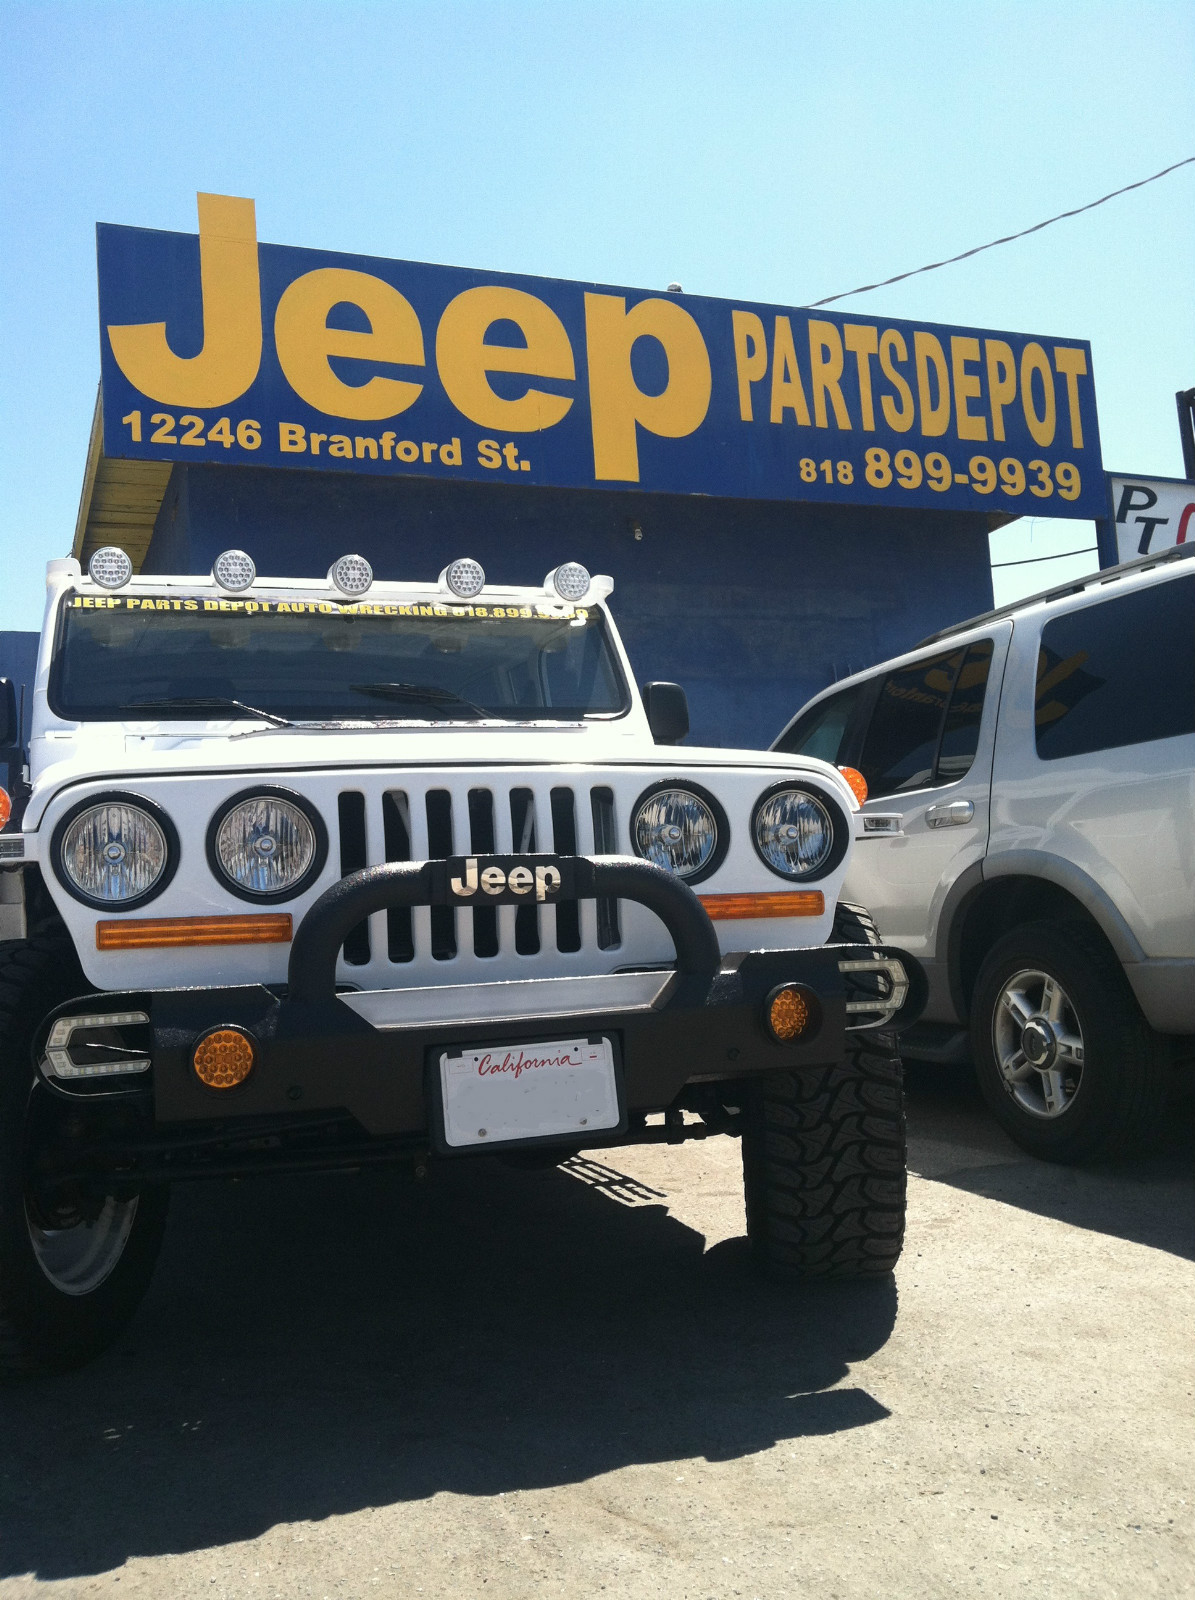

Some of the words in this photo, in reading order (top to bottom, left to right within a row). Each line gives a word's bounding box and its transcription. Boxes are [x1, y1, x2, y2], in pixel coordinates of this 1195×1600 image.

[107, 191, 712, 483] Jeep
[121, 410, 262, 450] 12246
[279, 421, 463, 466] Branford
[477, 439, 531, 472] St.
[799, 457, 855, 485] 818
[865, 447, 1082, 501] 899-9939
[72, 597, 121, 609] JEEP
[126, 599, 199, 611] PARTS
[203, 600, 273, 613] DEPOT
[276, 602, 333, 614] AUTO
[338, 604, 448, 617] WRECKING
[450, 858, 561, 901] Jeep
[477, 1050, 583, 1079] California
